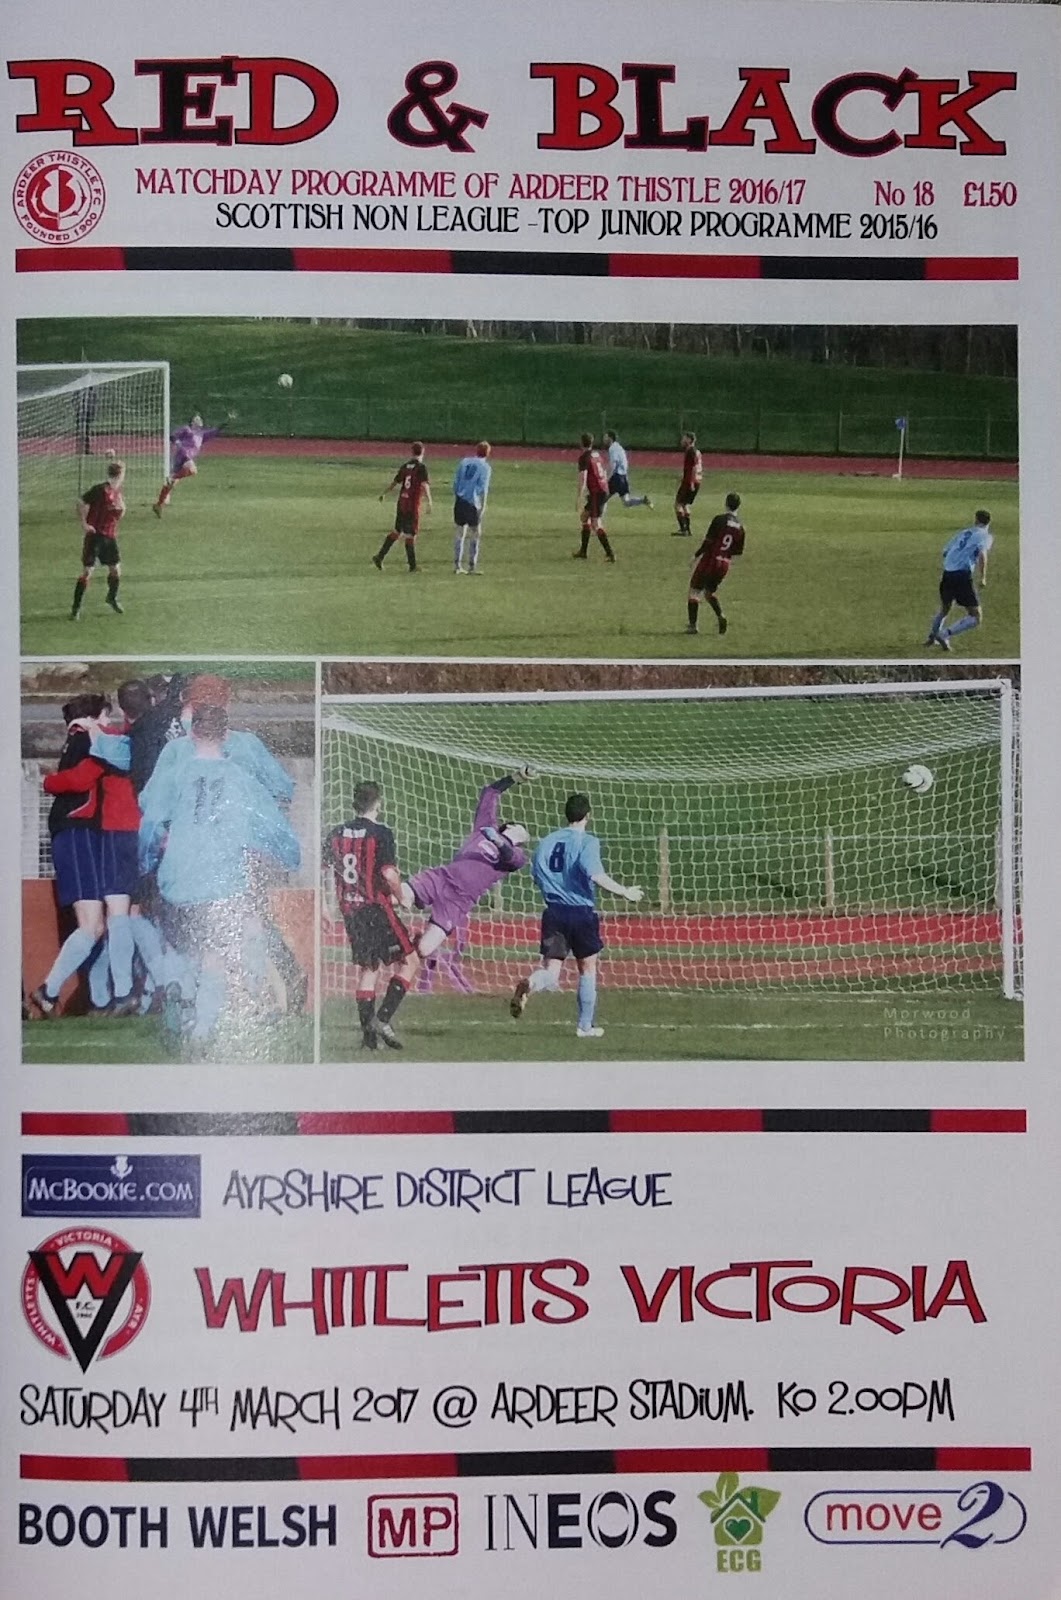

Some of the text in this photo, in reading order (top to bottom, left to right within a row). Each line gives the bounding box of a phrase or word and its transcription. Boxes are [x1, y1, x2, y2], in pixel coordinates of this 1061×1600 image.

[7, 55, 1018, 157] RED & BLACK
[17, 153, 102, 207] ARDEER THISTLE FC
[135, 168, 806, 205] MATCHDAY PROGRAMME OF ARDEER THISTLE 2016/17
[874, 180, 935, 206] No 18
[963, 181, 1018, 207] £1.50
[21, 212, 97, 241] FOUNDED 1900
[216, 203, 344, 230] SCOTTISH
[353, 204, 408, 231] NON
[417, 205, 520, 233] LEAGUE
[598, 208, 682, 240] JUNIOR
[690, 211, 852, 239] PROGRAMME
[860, 213, 938, 240] 2015/16
[720, 534, 733, 551] 9
[343, 853, 359, 884] 8
[547, 1167, 673, 1208] LEAGUE
[54, 1230, 113, 1247] VICTORIA
[194, 1258, 988, 1336] WHITLETTS VICTORIA
[20, 1383, 167, 1435] SATURDAY
[230, 1386, 341, 1433] MARCH
[353, 1387, 418, 1424] 2017
[432, 1385, 477, 1428] @
[491, 1381, 618, 1429] ARDEER
[828, 1378, 955, 1422] 2.00PM
[18, 1503, 337, 1549] BOOTH WELSH
[378, 1506, 452, 1548] MP
[484, 1489, 678, 1551] INEOS
[716, 1549, 762, 1573] ECG
